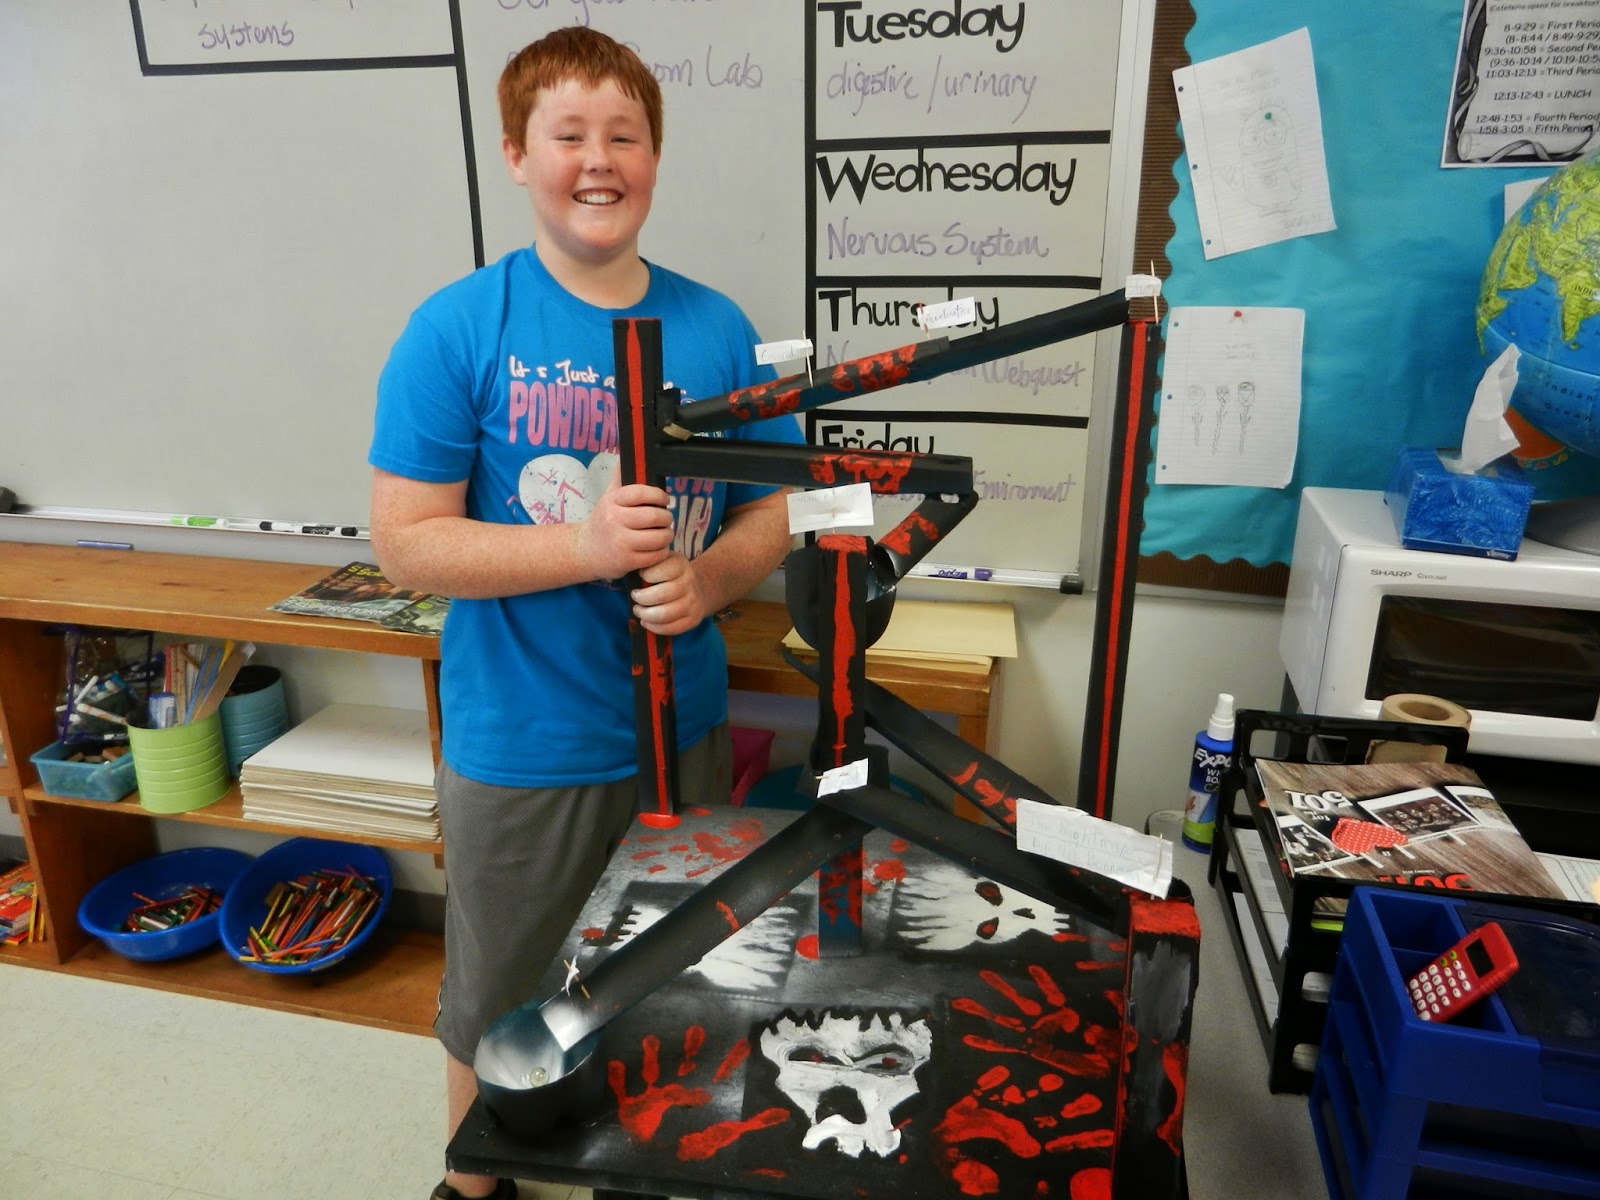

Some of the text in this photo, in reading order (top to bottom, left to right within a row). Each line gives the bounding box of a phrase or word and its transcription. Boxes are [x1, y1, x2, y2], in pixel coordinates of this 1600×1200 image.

[818, 0, 1026, 53] Tuesday
[1547, 21, 1573, 30] First
[1547, 43, 1585, 54] Second
[1552, 54, 1600, 65] 10:19-10:5
[706, 44, 764, 89] Lab
[1547, 67, 1574, 76] Third
[1554, 89, 1593, 99] LUNCH
[1533, 112, 1567, 122] Fourth
[1534, 124, 1560, 134] Fifth
[816, 146, 1077, 206] Wednesday
[827, 215, 938, 261] Nervous
[817, 286, 1001, 333] Thursy
[554, 358, 601, 387] Just
[1369, 568, 1413, 578] SHARP
